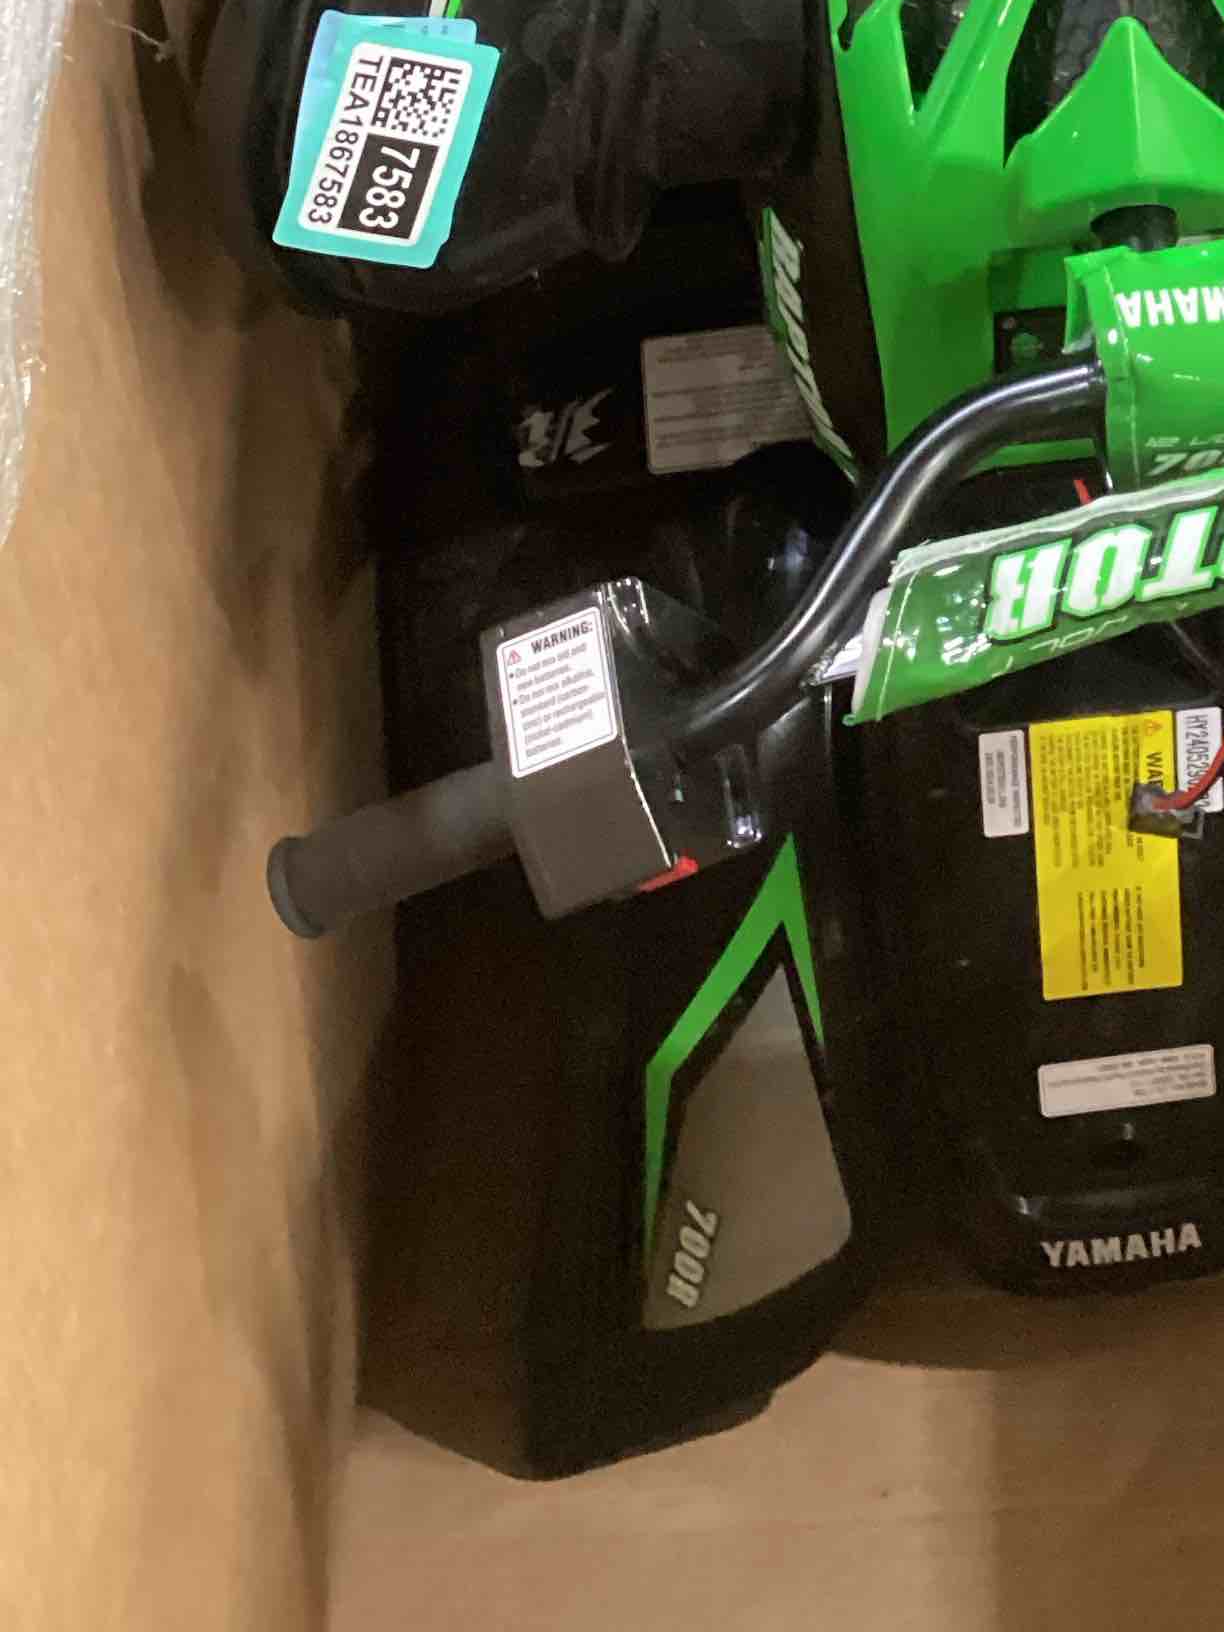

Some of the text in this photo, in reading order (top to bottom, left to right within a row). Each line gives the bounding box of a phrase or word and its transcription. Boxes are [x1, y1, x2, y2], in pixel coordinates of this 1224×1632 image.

[307, 55, 382, 225] TEA1867583
[358, 145, 421, 229] 7583
[531, 621, 593, 654] WARNING:
[664, 1199, 719, 1308] 700R
[1040, 1221, 1203, 1268] YAMAHA
